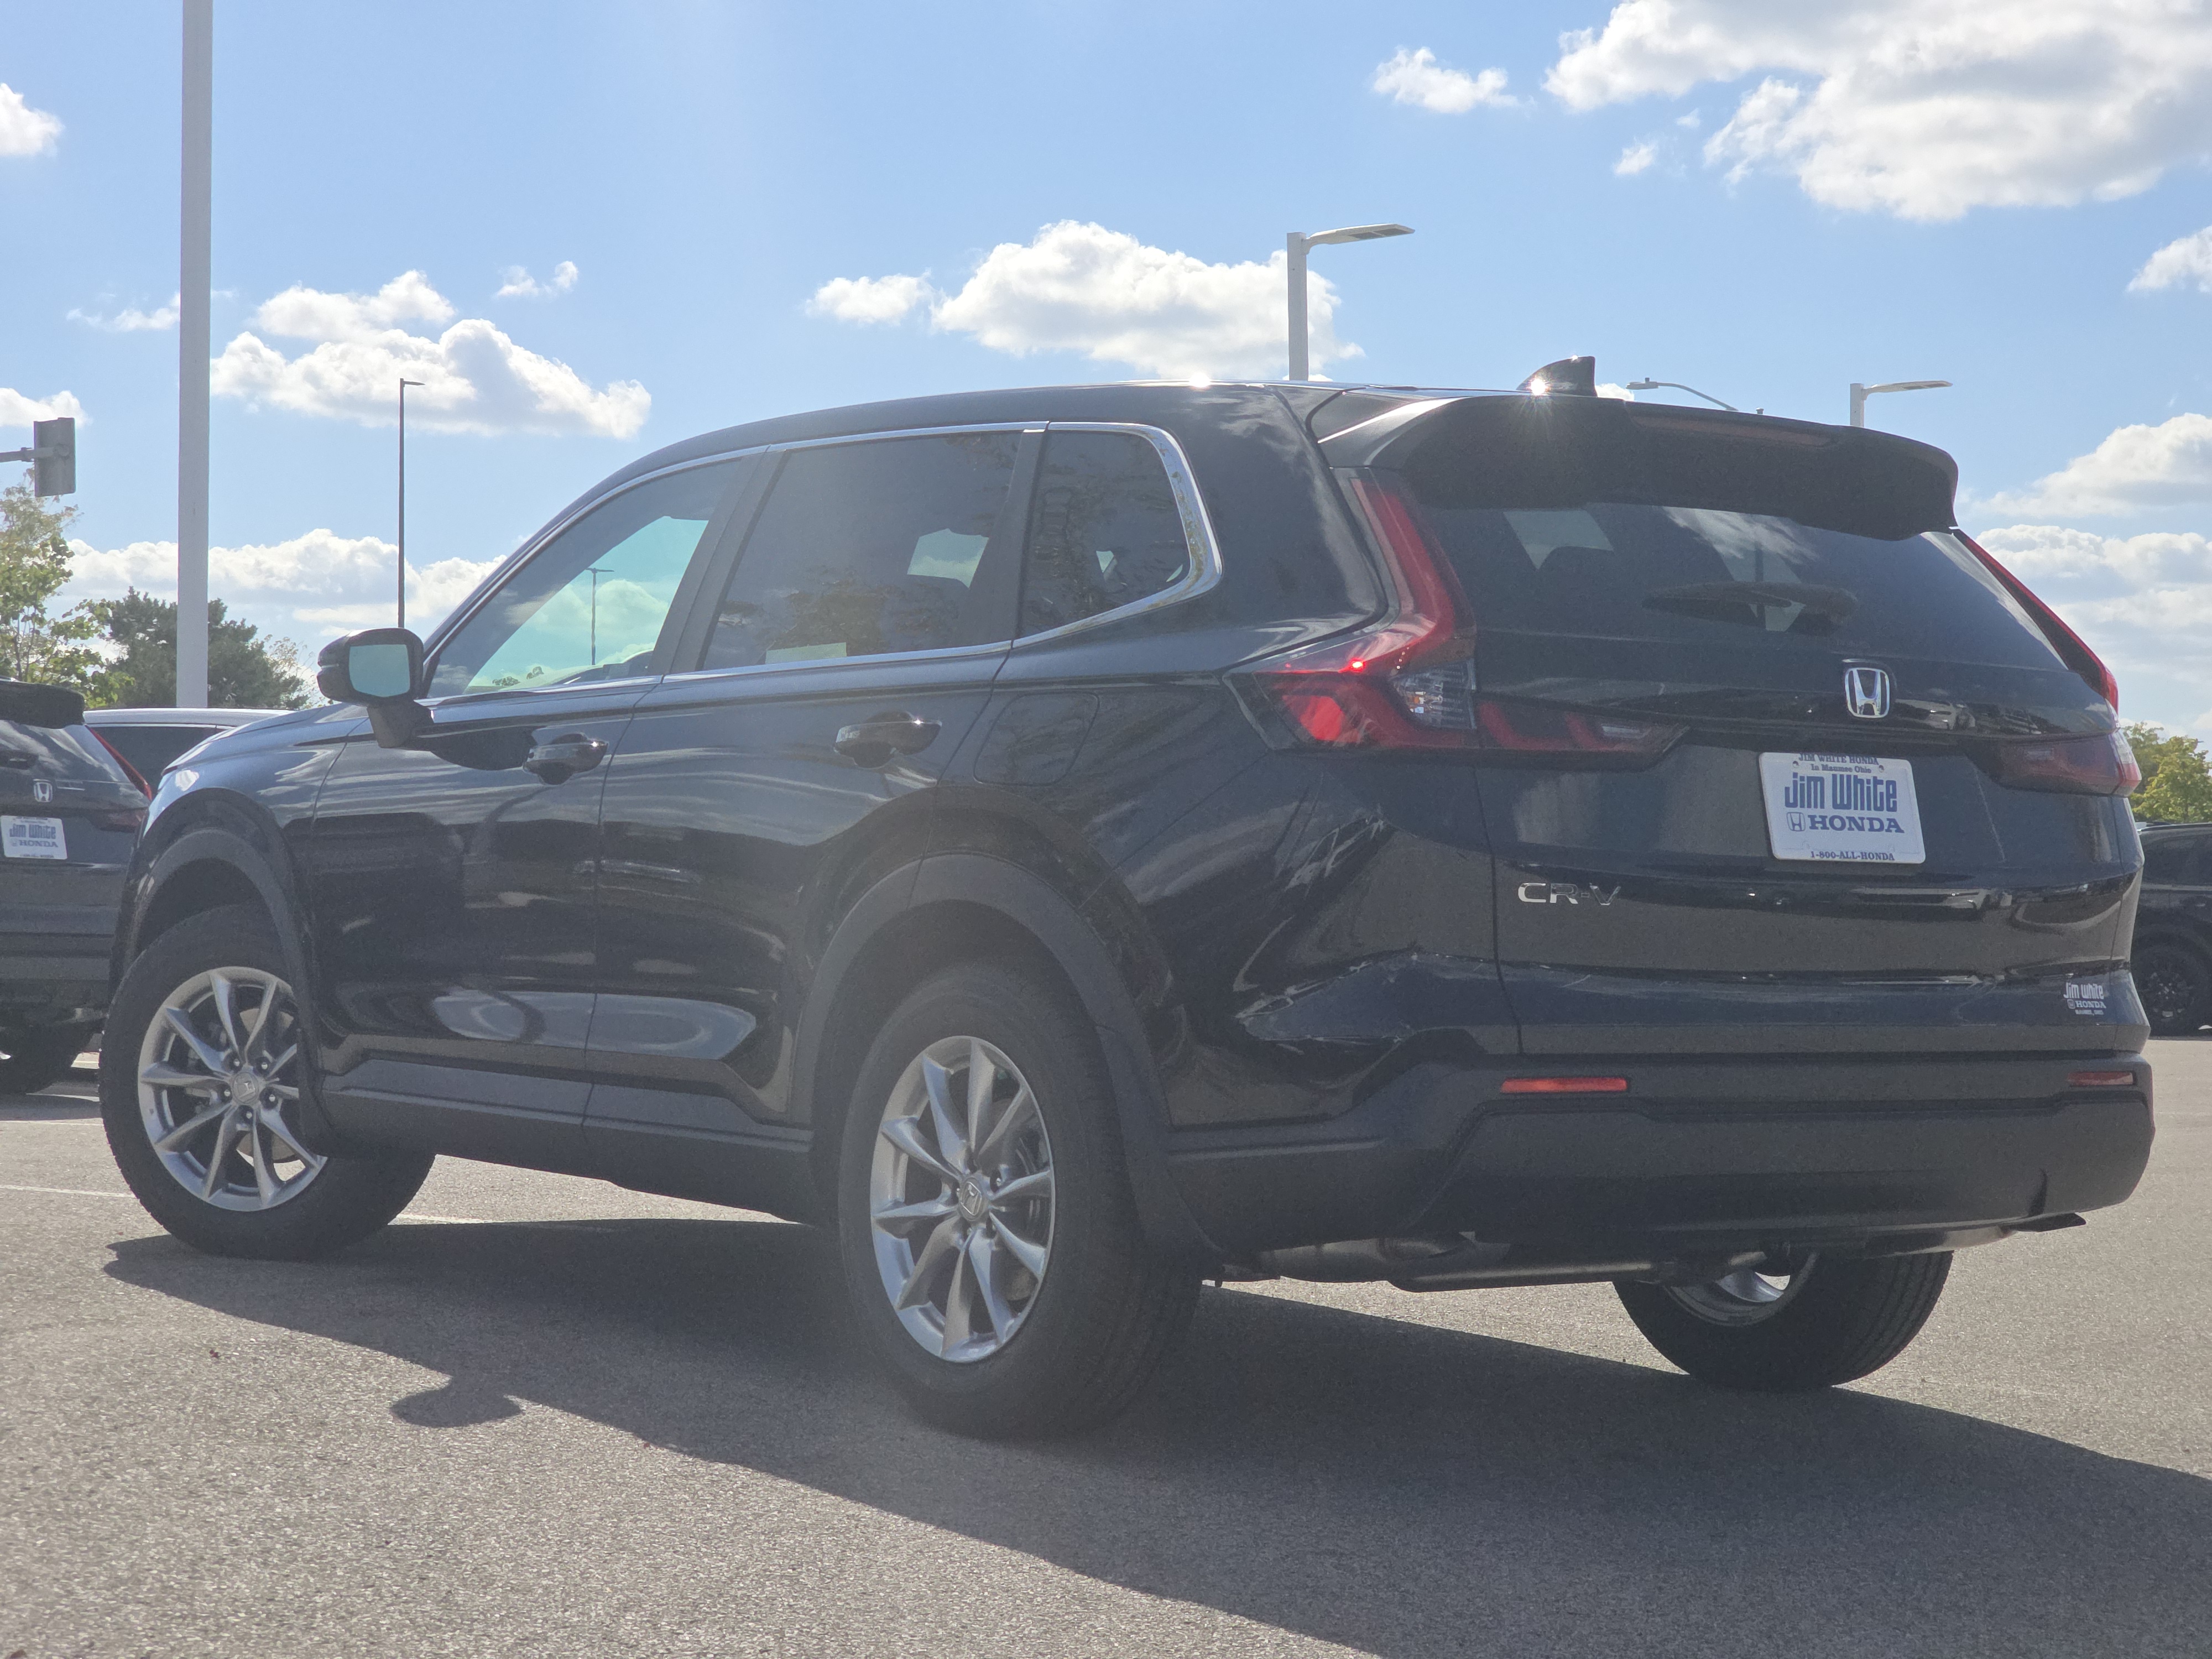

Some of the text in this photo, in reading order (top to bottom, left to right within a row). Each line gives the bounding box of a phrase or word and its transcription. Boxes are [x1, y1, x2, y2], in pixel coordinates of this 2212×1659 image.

[1798, 753, 1879, 765] JIM WHITE HONDA
[1821, 764, 1853, 773] Maumee
[1854, 765, 1872, 774] Ohio
[1832, 774, 1897, 812] White
[1807, 815, 1905, 833] HONDA
[1811, 851, 1895, 861] 1-800-ALL-HONDA
[1518, 883, 1621, 906] CR-V
[2075, 1000, 2106, 1009] HONDA
